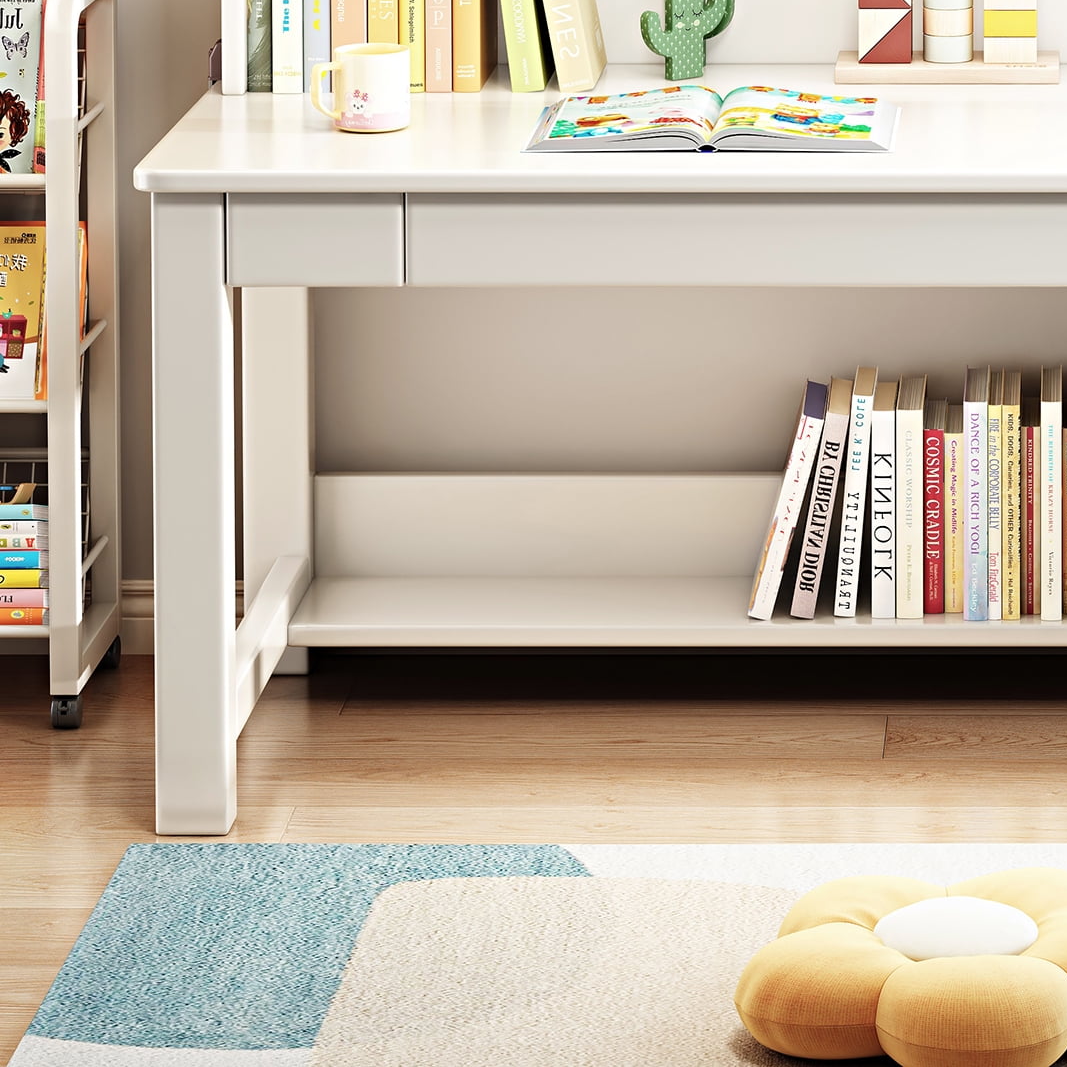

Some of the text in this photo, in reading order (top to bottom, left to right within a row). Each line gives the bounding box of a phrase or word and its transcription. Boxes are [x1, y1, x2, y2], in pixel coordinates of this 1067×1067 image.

[970, 413, 980, 454] DANCE
[905, 430, 913, 528] CLASSIC WORSHIP
[925, 437, 940, 495] COSMIC
[970, 458, 980, 475] OF
[970, 479, 980, 487] A
[970, 492, 980, 520] RICH
[989, 418, 1000, 602] FIRE in the CORPORATE BELLY Tom FitzGerald
[925, 499, 940, 562] CRADLE
[970, 524, 980, 555] YOGI
